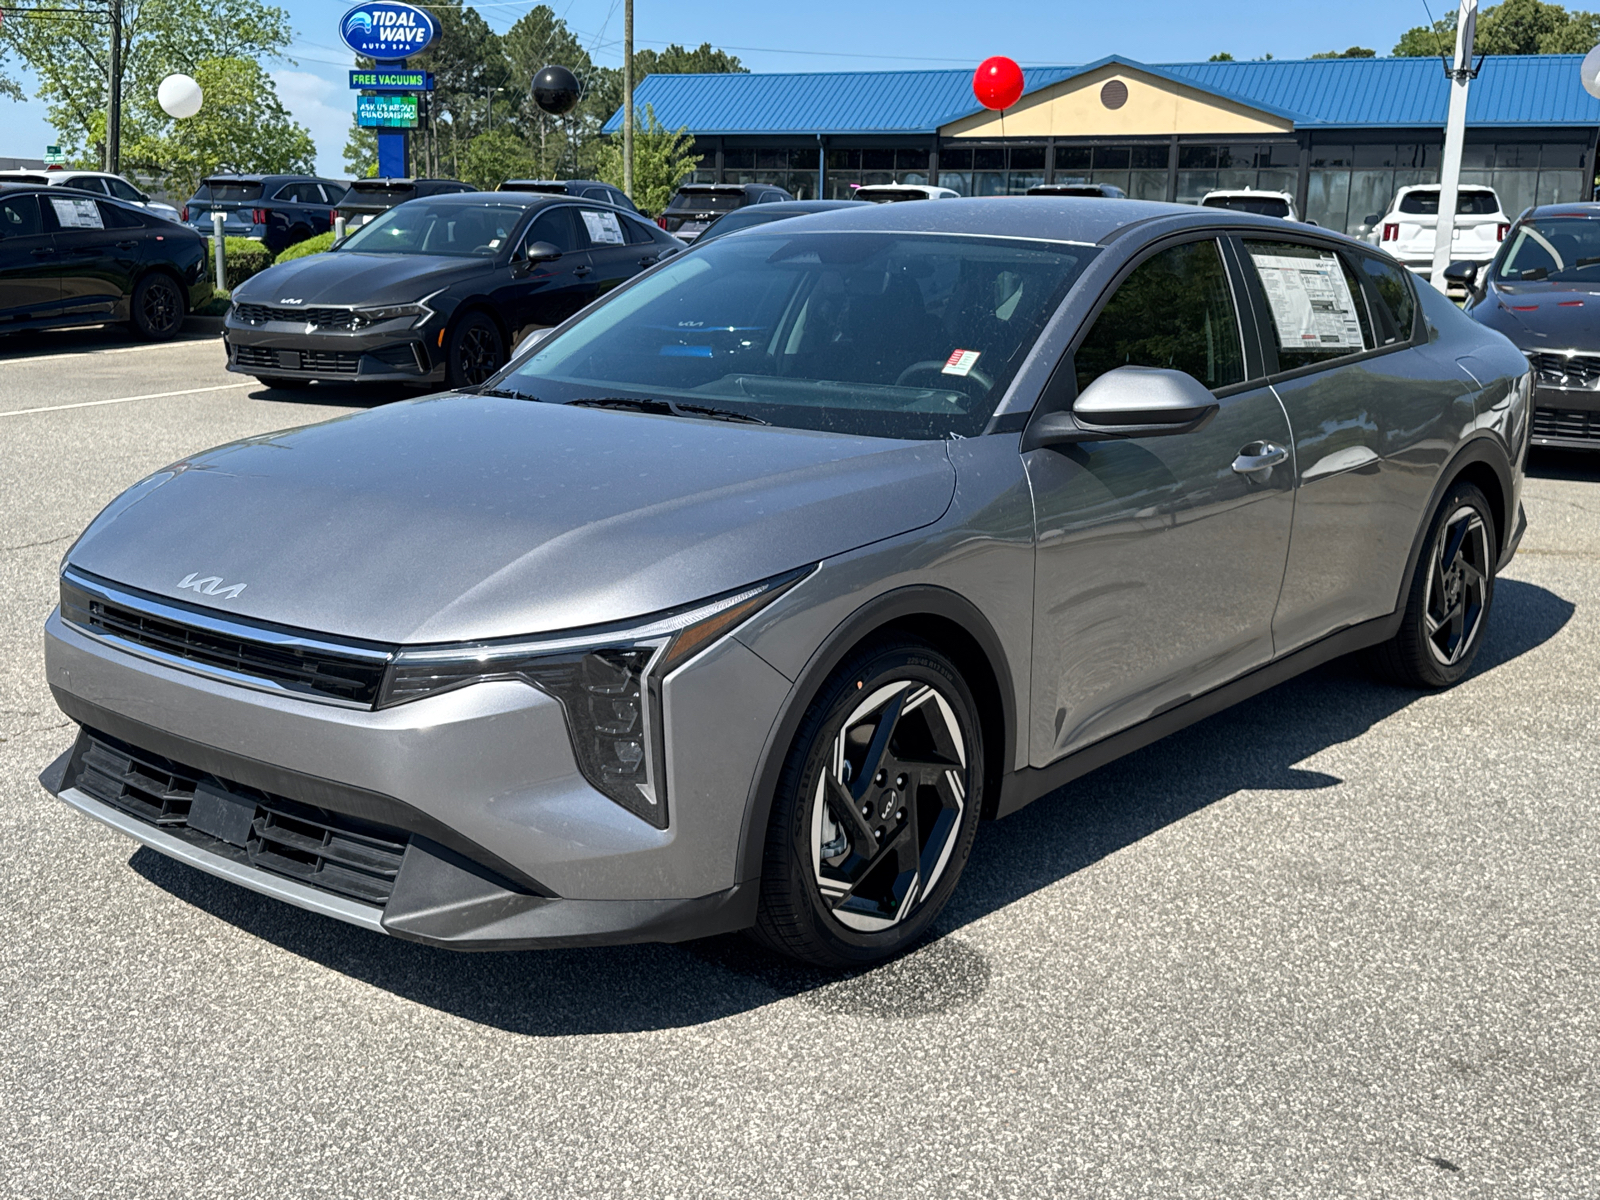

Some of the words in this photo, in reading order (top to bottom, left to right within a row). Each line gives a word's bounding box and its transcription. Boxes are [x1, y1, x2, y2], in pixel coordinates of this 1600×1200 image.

[372, 11, 416, 26] TIDAL
[380, 27, 425, 42] WAVE
[352, 74, 377, 85] FREE
[379, 75, 423, 85] VACUUMS
[360, 103, 375, 111] ASK
[377, 103, 388, 111] US
[389, 103, 416, 112] ABOUT
[361, 111, 416, 119] FUNDRAISING
[176, 572, 248, 599] KIA
[794, 757, 815, 838] SOLUS
[962, 786, 982, 860] KUMHO
